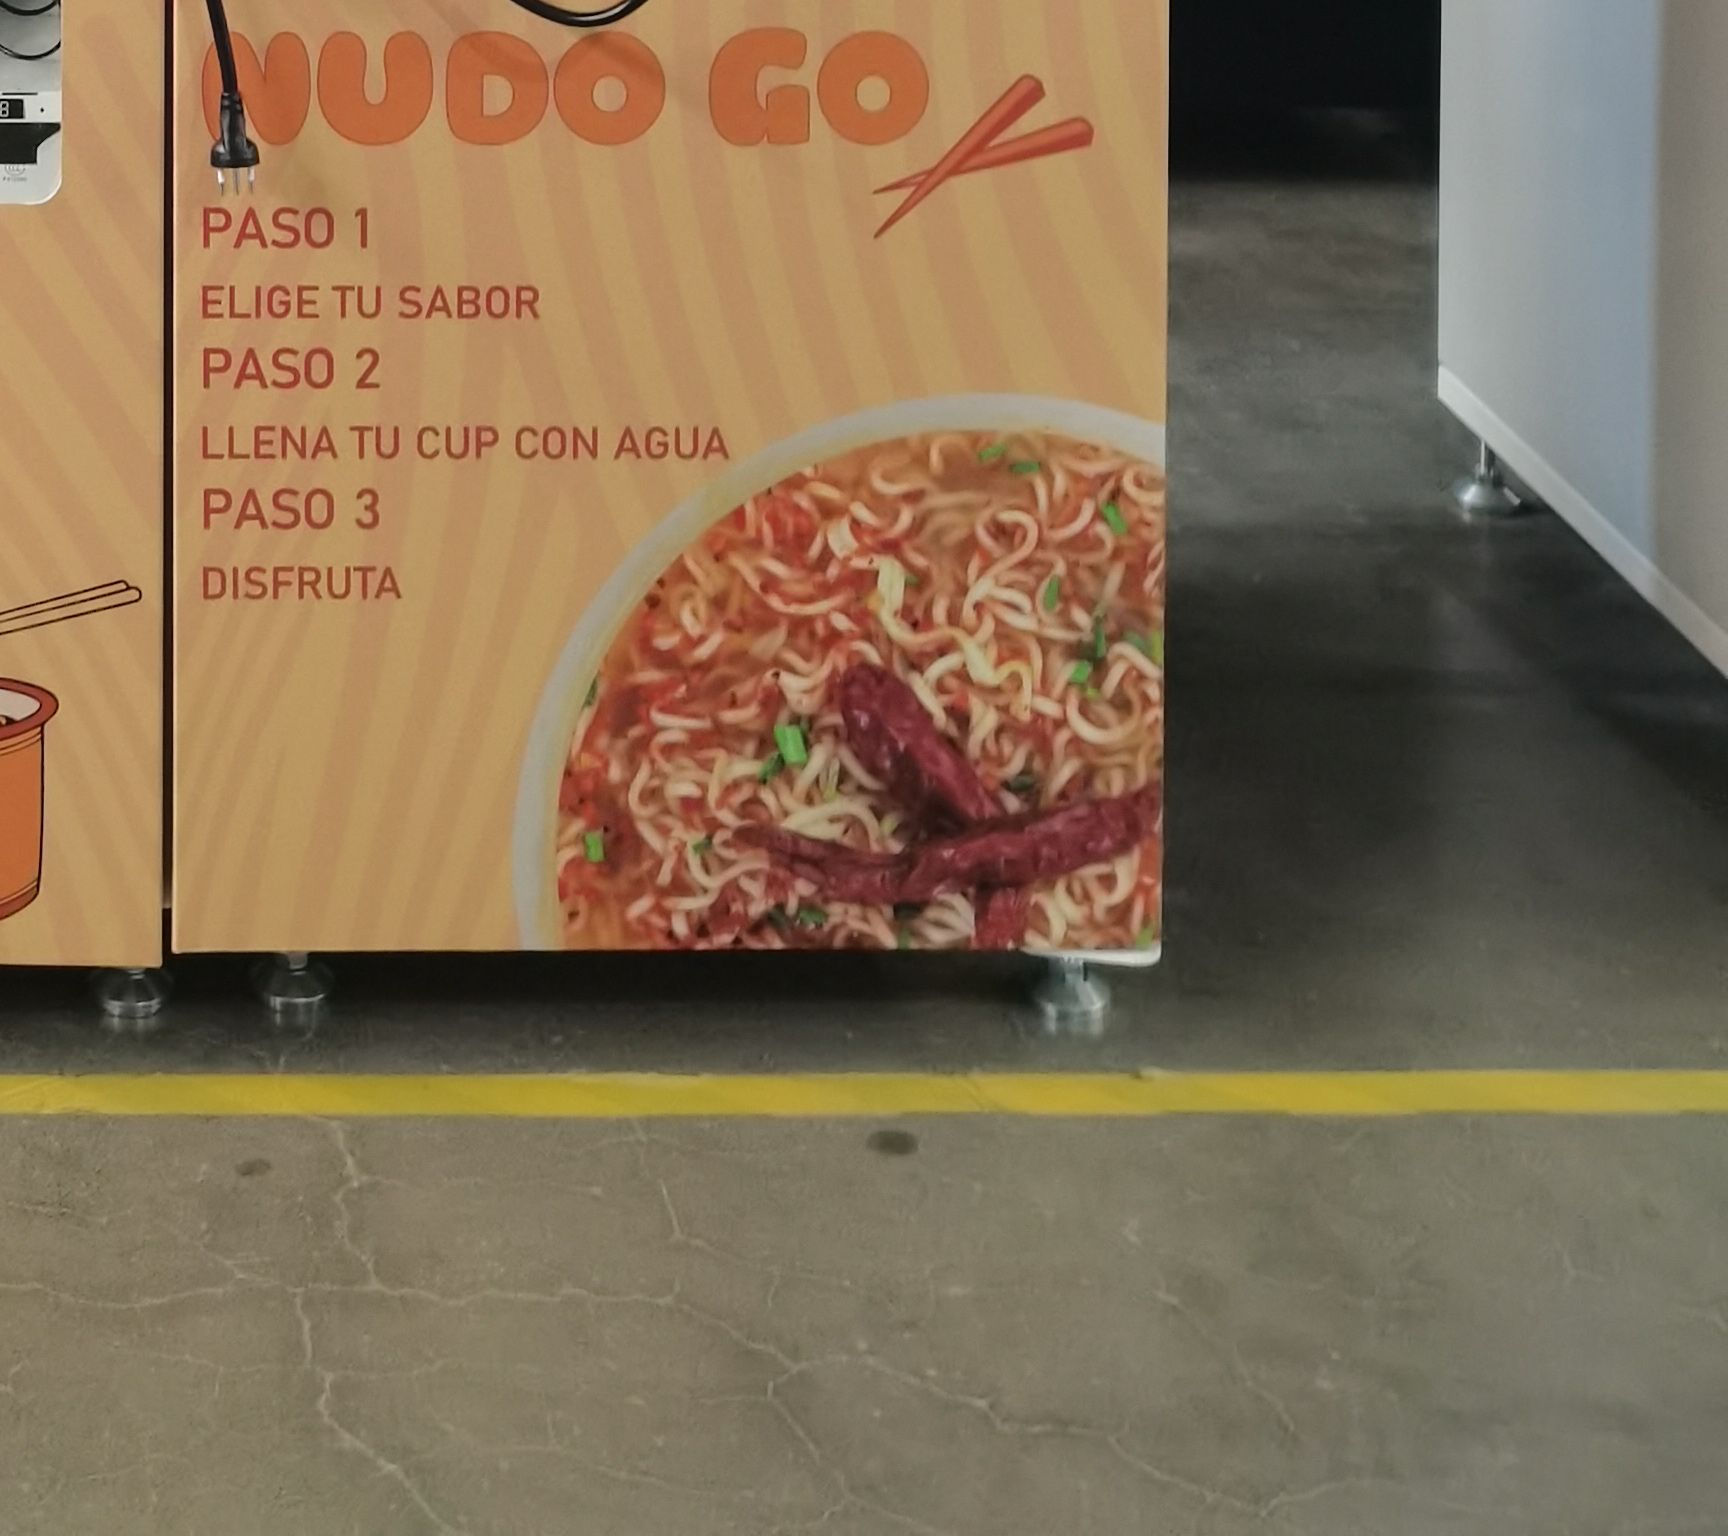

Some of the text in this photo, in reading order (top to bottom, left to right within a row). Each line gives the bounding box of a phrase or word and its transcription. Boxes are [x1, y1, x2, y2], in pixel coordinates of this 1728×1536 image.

[201, 27, 930, 146] NUDO GO
[202, 207, 369, 249] PASO 1
[202, 286, 540, 319] ELIGE TU SABOR
[202, 347, 381, 389] PASO 2
[202, 426, 729, 460] LLENA TU CUP CON AGUA
[202, 488, 380, 530] PASO 3
[202, 567, 401, 600] DISFRUTA
